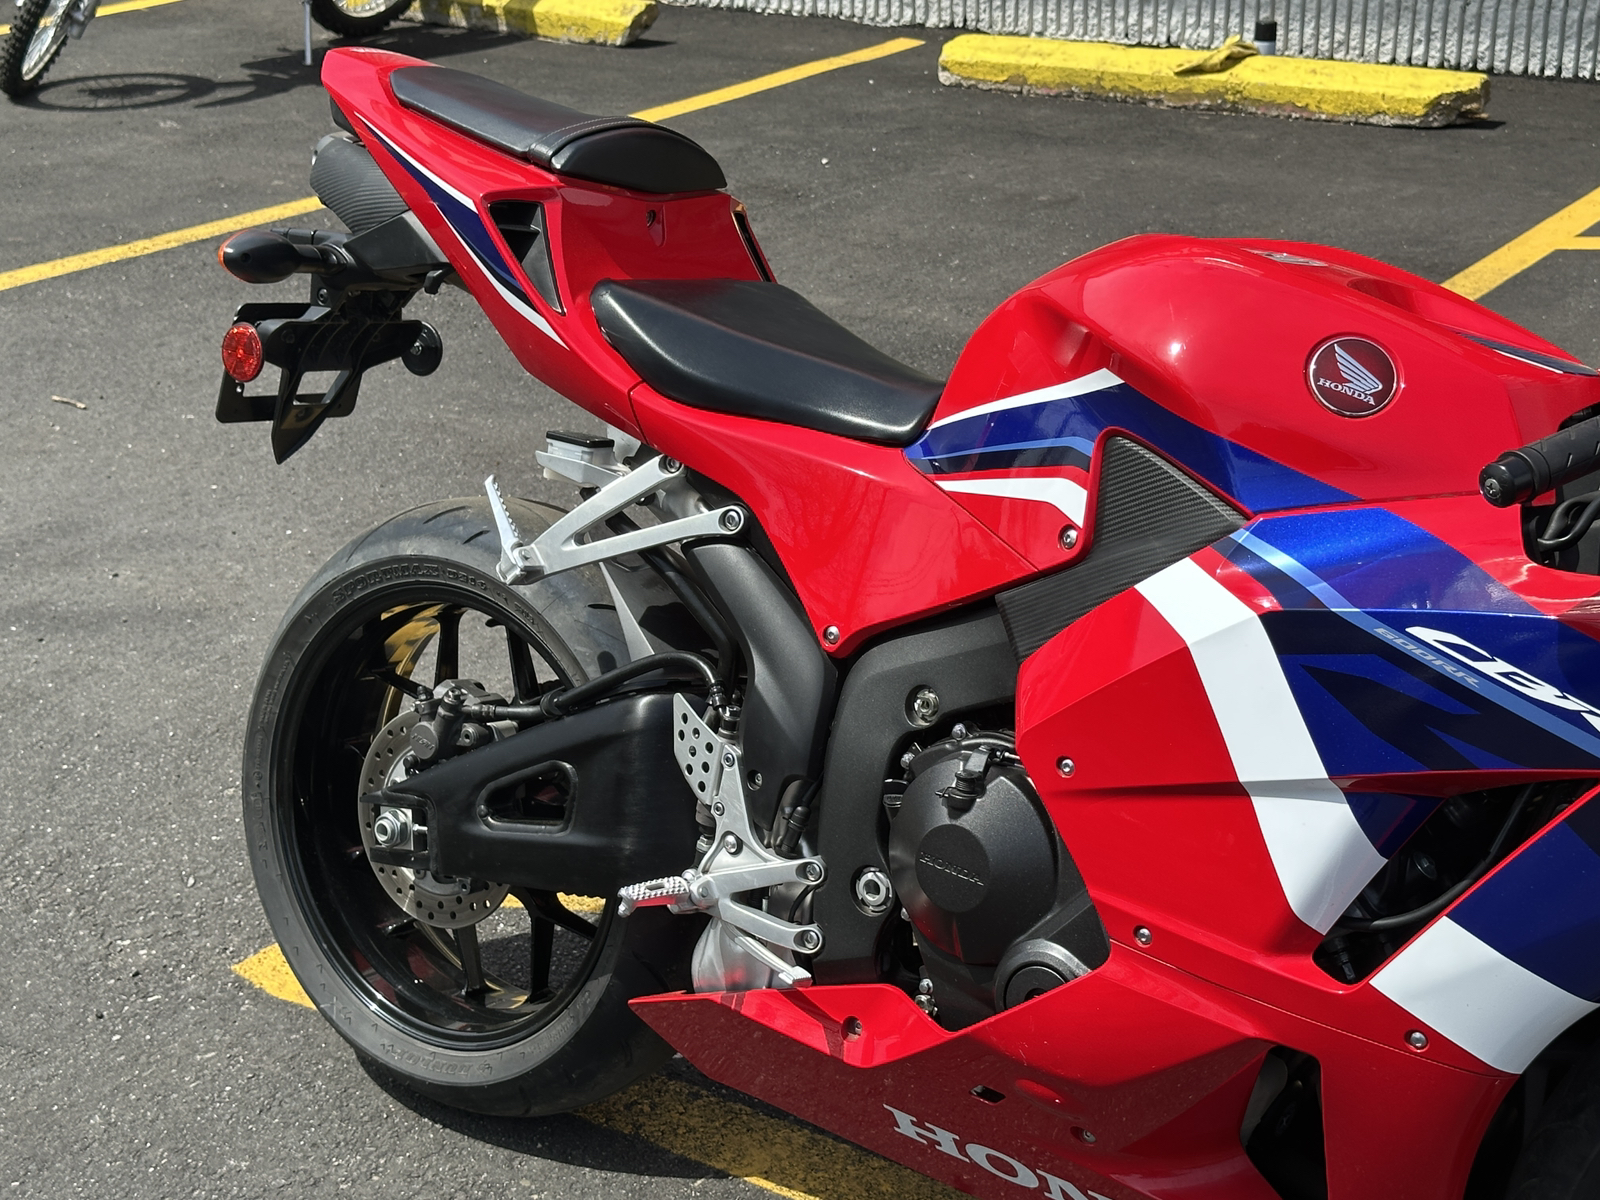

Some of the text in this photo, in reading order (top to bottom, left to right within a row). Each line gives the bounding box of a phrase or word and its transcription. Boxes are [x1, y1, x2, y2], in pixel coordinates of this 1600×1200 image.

[1317, 377, 1375, 406] HONDA
[332, 563, 440, 603] SPORTMAX
[1373, 627, 1481, 689] 600RR
[919, 851, 985, 887] HONDA
